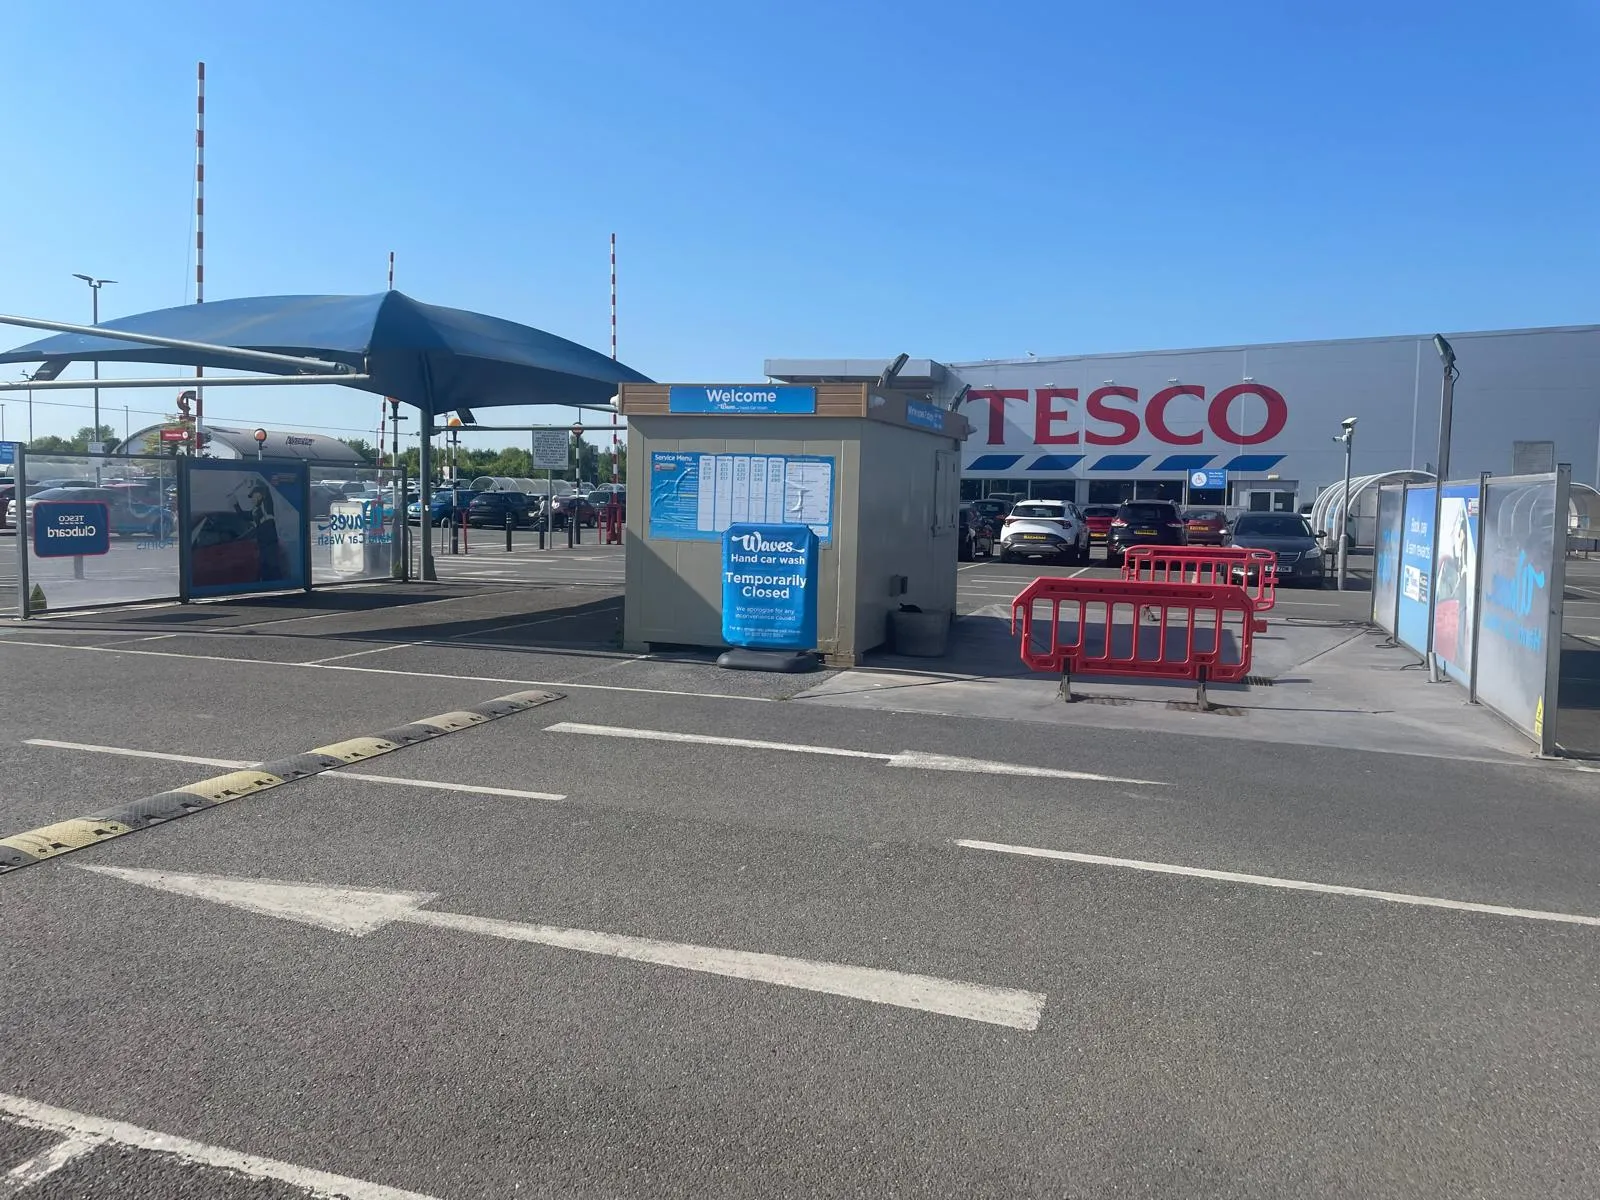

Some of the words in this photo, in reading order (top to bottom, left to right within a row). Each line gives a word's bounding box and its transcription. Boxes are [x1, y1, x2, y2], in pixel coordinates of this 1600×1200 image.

[706, 389, 777, 402] Welcome
[966, 383, 1288, 446] TESCO
[731, 531, 805, 553] Waves
[731, 553, 758, 563] Hand
[760, 556, 777, 564] car
[779, 555, 806, 565] wash
[725, 572, 808, 589] Temporarily
[742, 586, 790, 599] Closed
